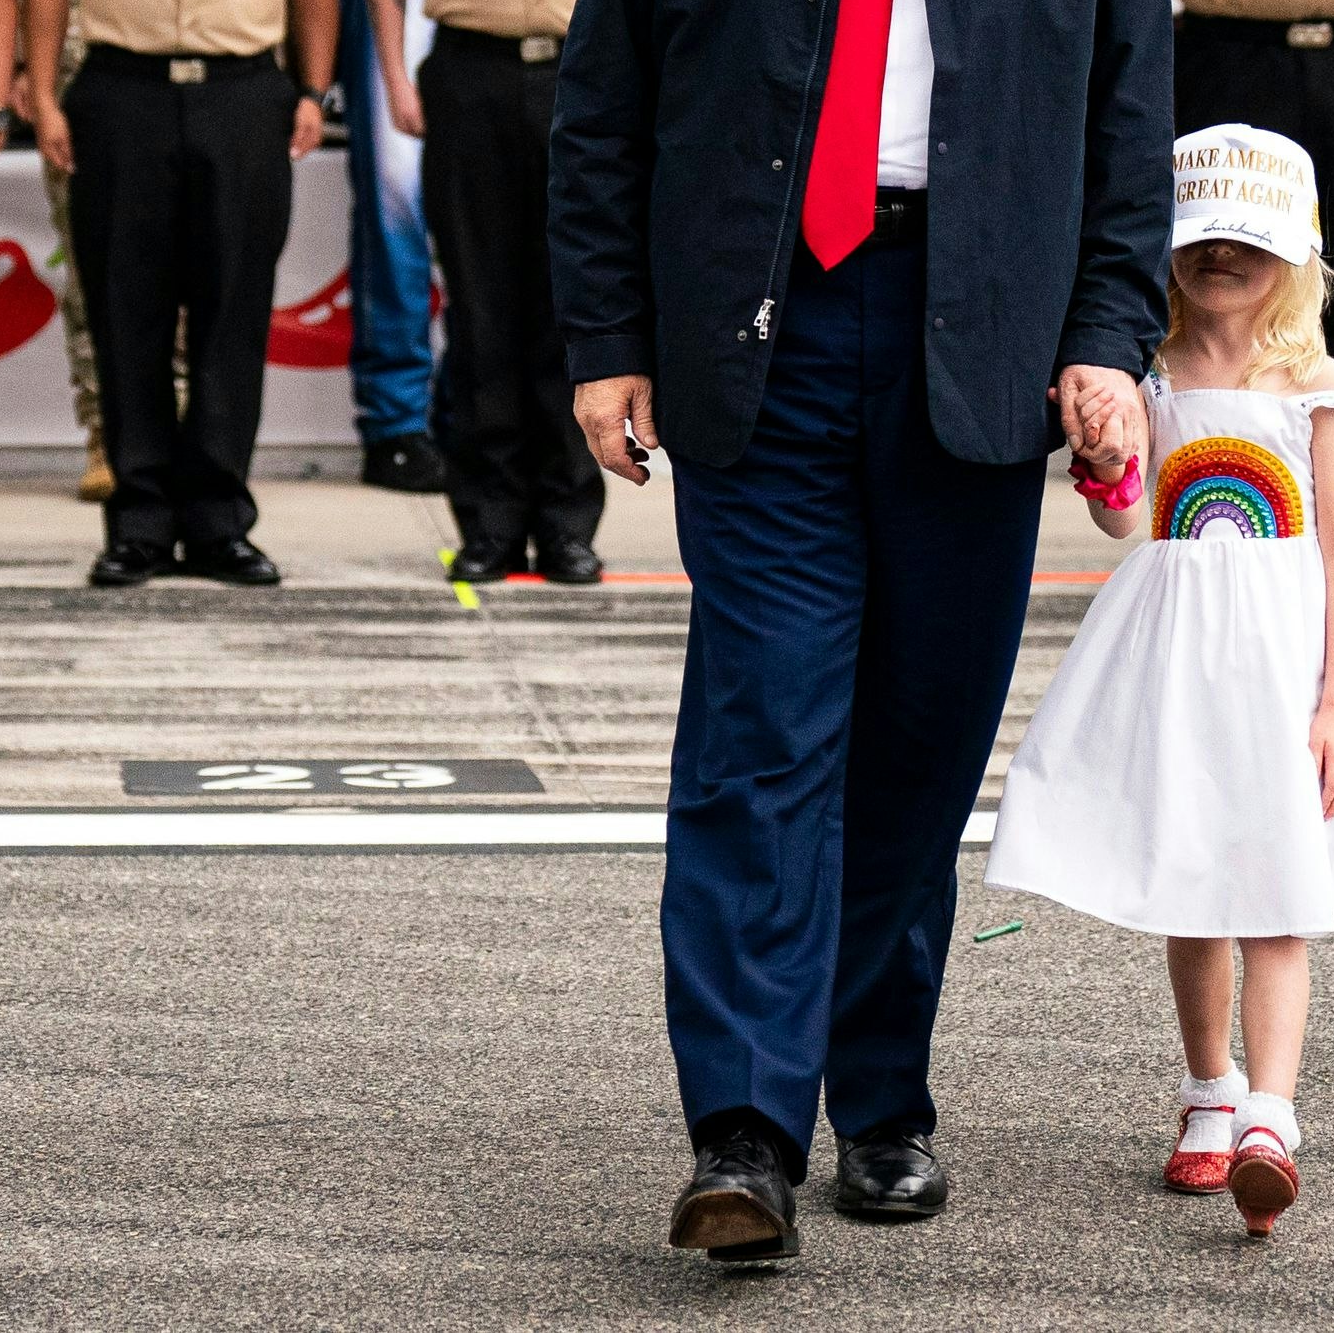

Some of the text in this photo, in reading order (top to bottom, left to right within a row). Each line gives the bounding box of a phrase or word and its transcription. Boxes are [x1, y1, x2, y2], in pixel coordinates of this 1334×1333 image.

[1172, 147, 1305, 188] MAKE AMERICA
[1176, 179, 1294, 215] GREAT AGAIN
[198, 763, 457, 791] 23
